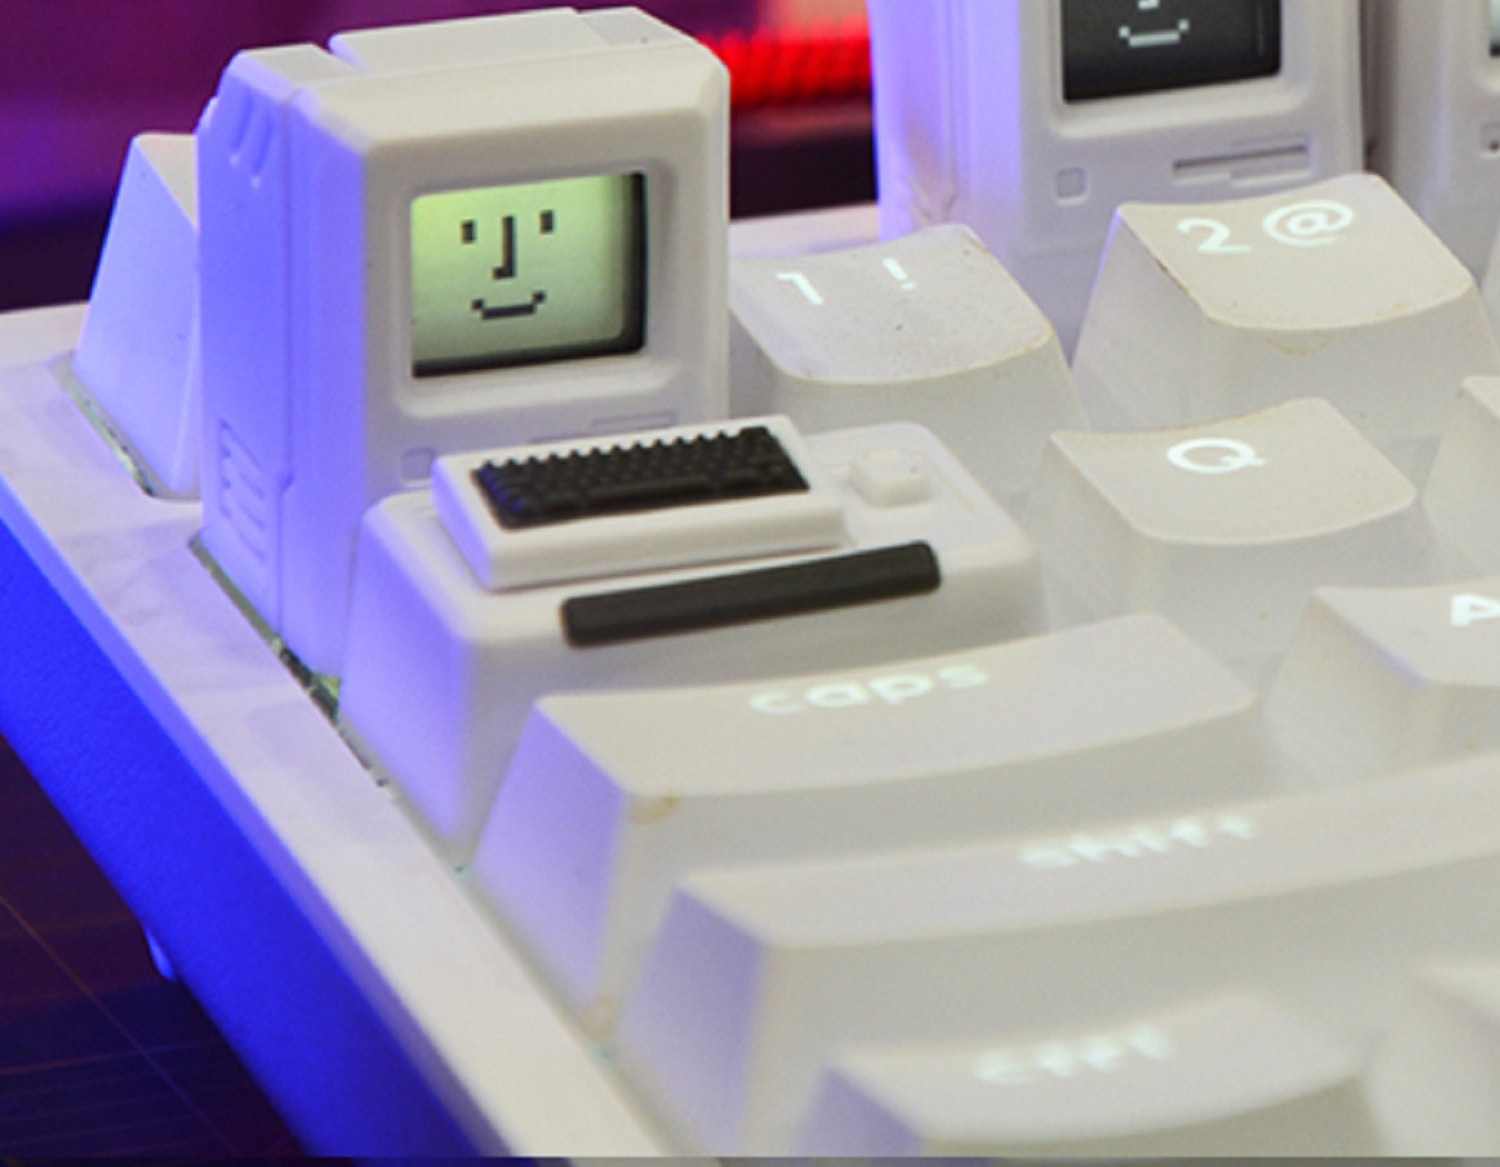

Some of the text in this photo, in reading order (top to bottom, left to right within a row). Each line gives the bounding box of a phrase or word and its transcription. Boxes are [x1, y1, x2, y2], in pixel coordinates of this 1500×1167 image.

[1177, 200, 1355, 253] 2 @
[775, 272, 822, 305] 1
[1167, 438, 1264, 474] Q
[750, 667, 987, 714] caps
